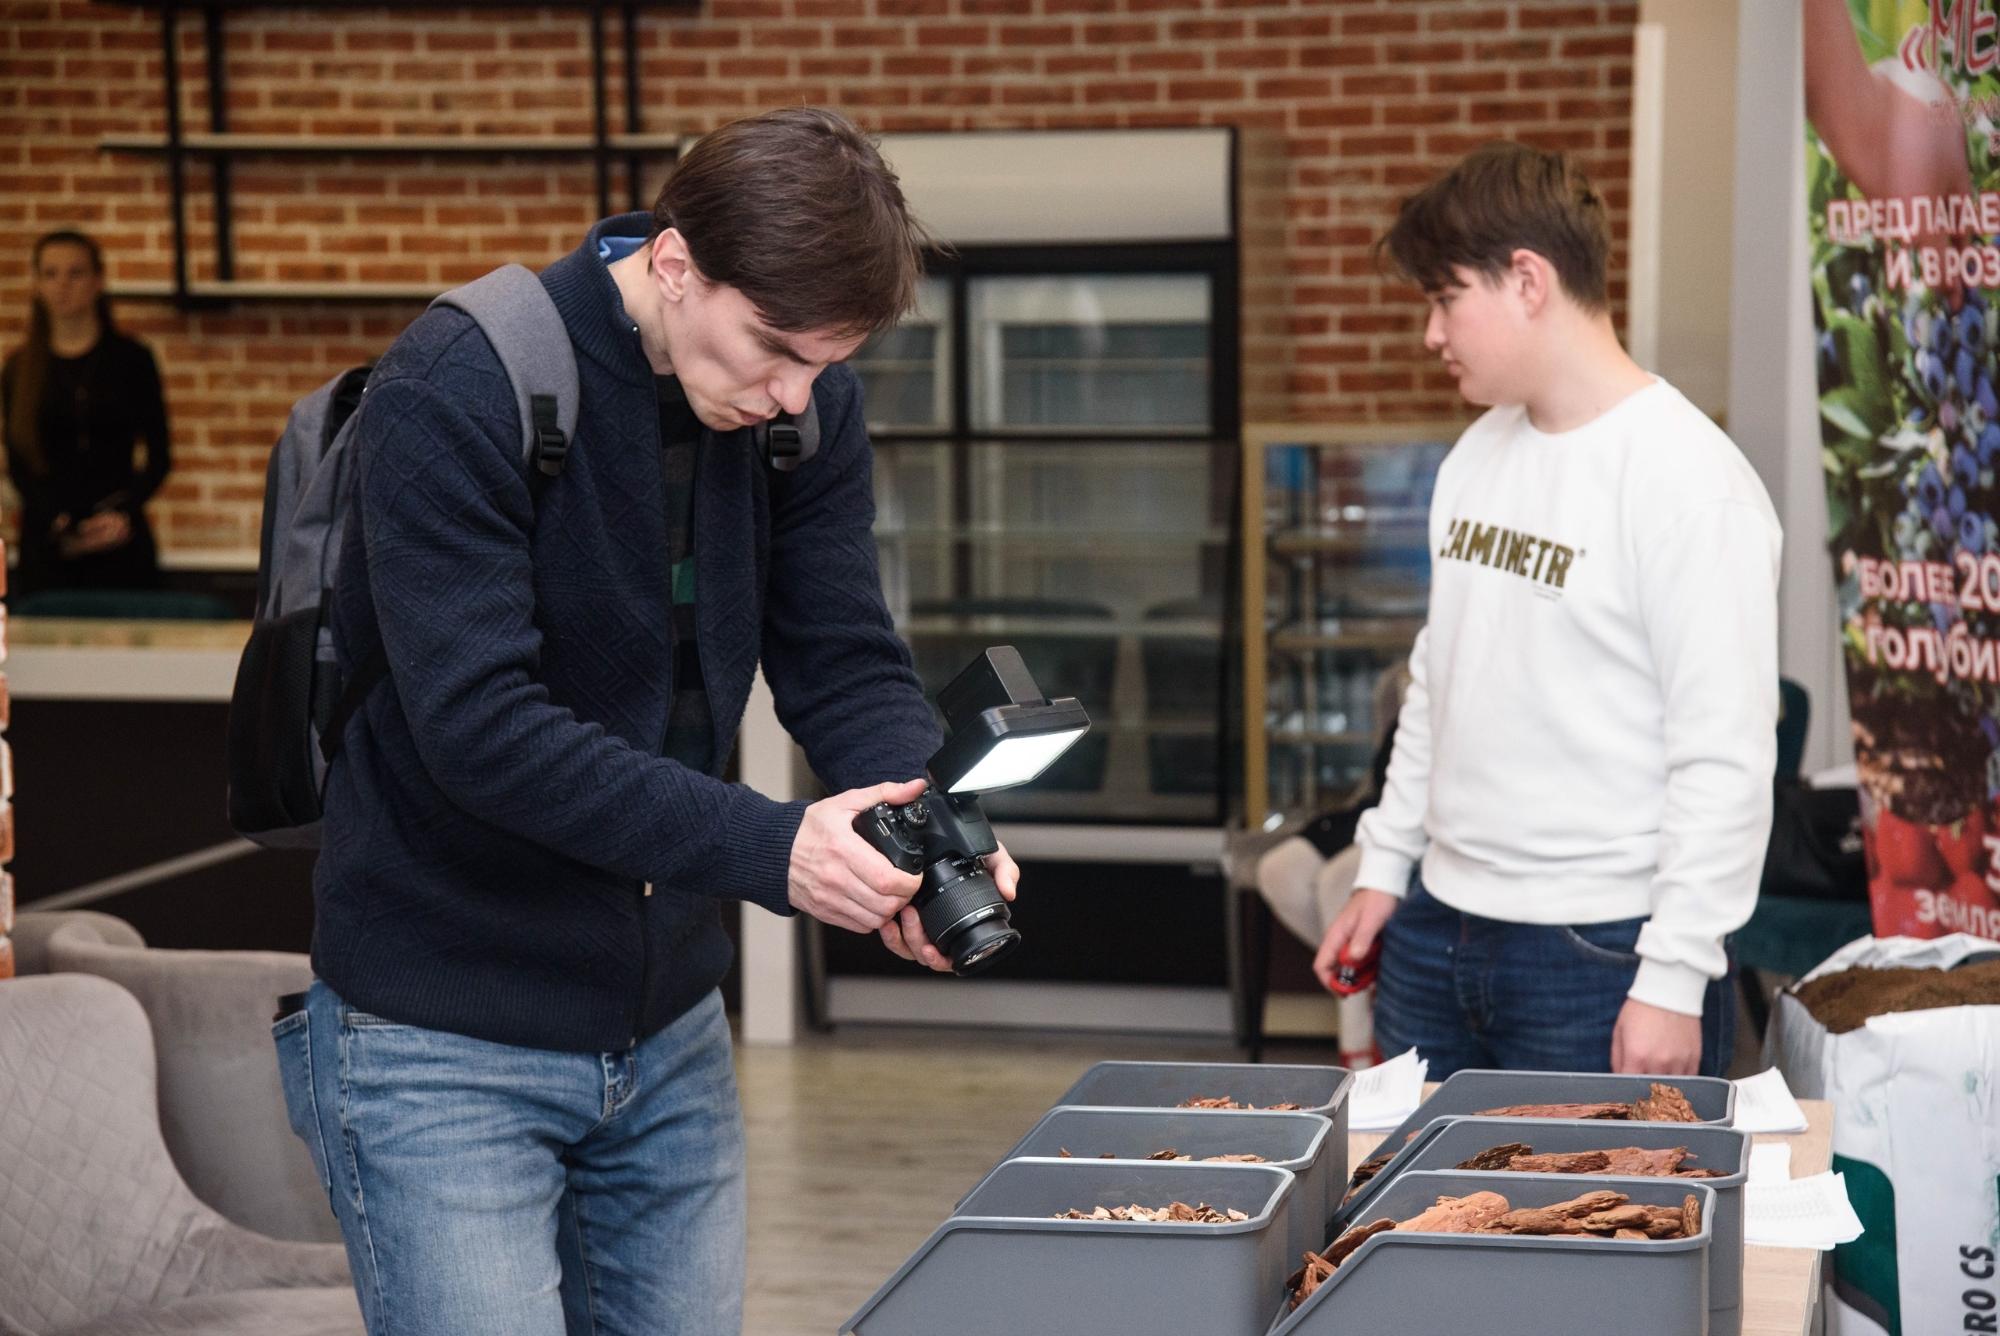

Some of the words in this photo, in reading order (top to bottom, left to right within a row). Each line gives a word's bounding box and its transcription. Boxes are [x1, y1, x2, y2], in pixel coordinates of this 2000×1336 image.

[1828, 192, 2000, 243] ПРЕДЛАГАЕ
[1886, 248, 1911, 288] И
[1919, 246, 1942, 287] В
[1945, 245, 2000, 288] РОЗ
[1859, 556, 1955, 603] БОЛЕЕ
[1956, 550, 2000, 613] 20
[1864, 620, 2000, 684] голуби
[1959, 1244, 1995, 1280] CS
[1961, 1287, 1998, 1336] RO
